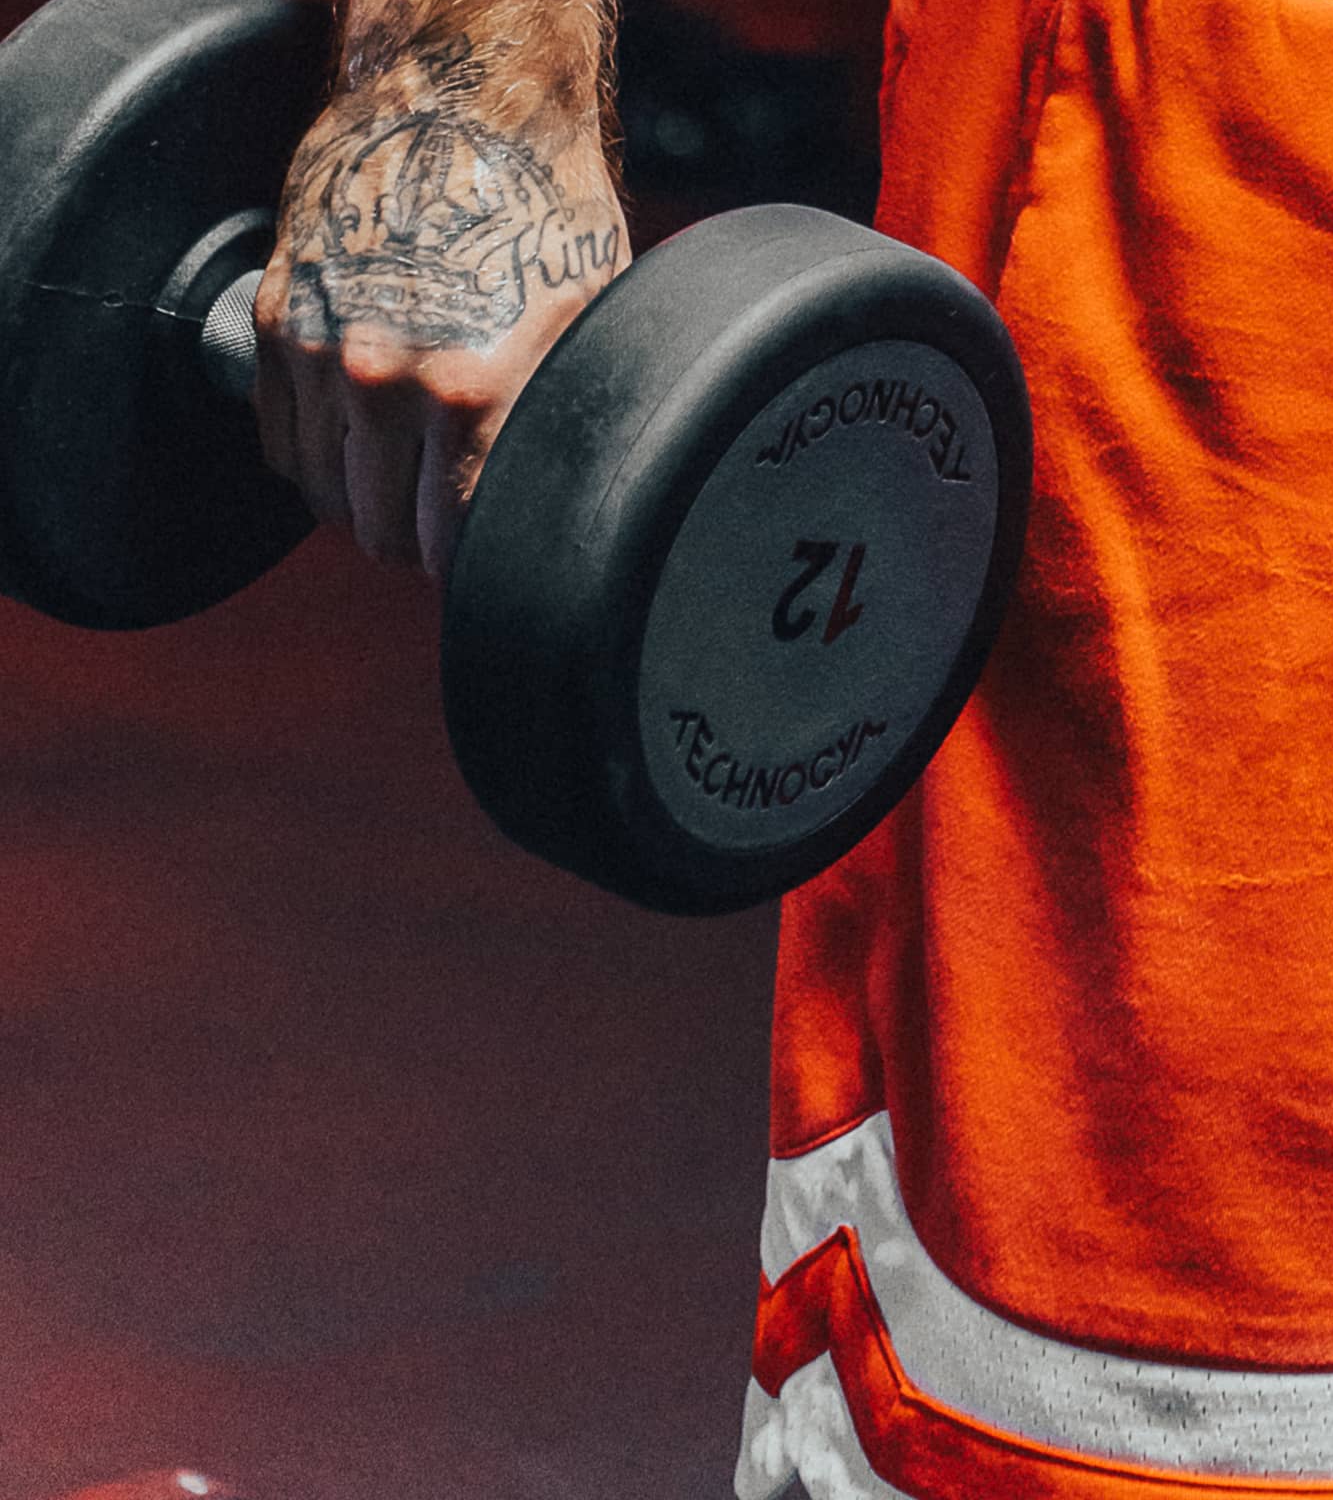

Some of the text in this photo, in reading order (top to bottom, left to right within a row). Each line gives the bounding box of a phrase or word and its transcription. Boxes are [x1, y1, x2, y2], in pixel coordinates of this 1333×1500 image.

[754, 378, 972, 485] TECHNOGYM
[771, 539, 868, 647] 12
[668, 709, 888, 810] TECHNOGYM
